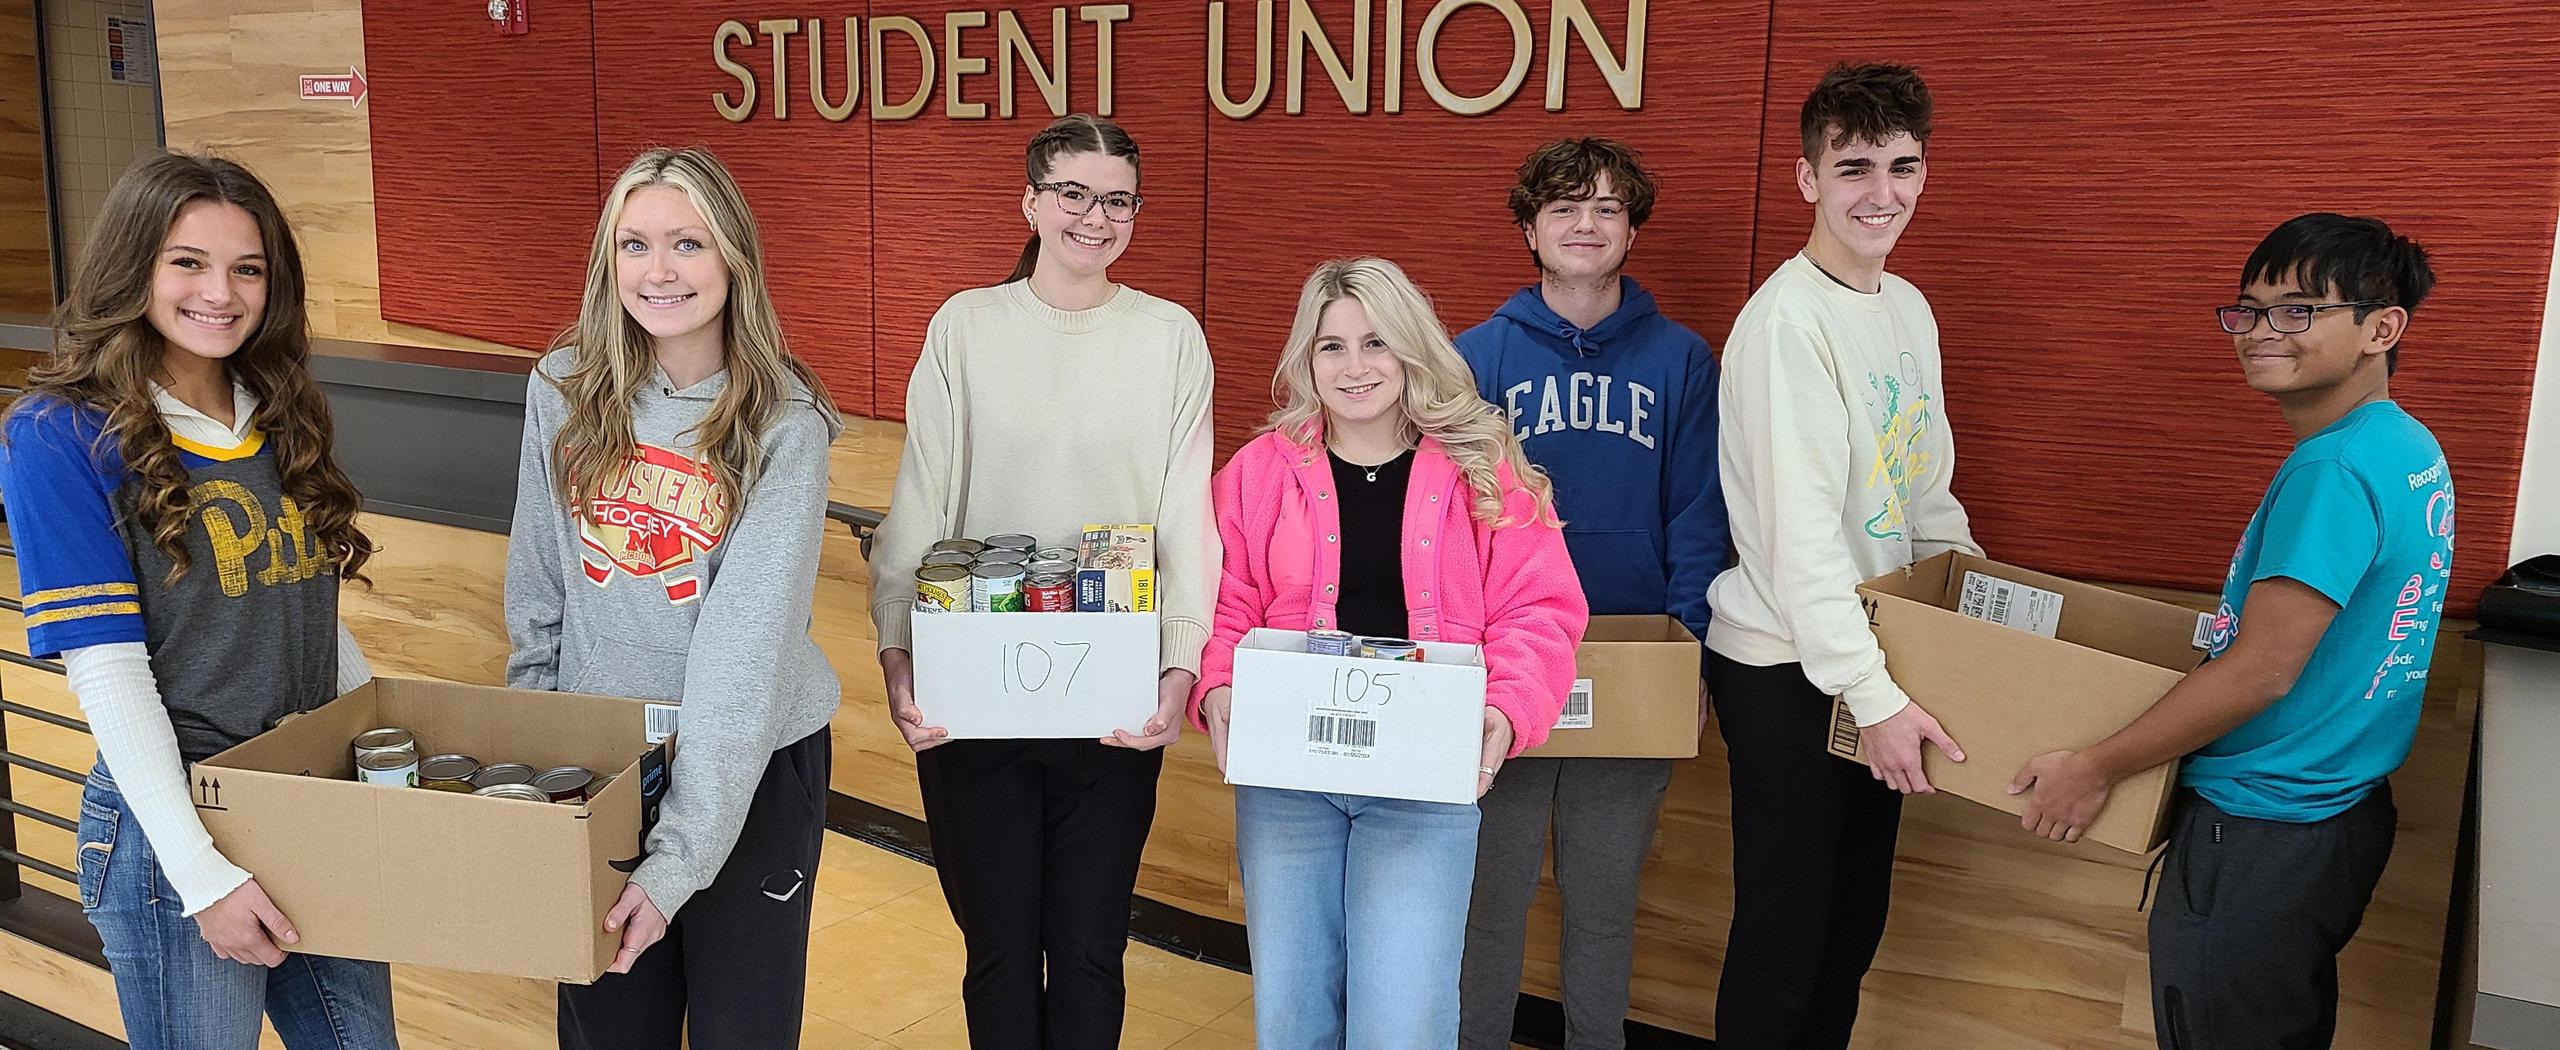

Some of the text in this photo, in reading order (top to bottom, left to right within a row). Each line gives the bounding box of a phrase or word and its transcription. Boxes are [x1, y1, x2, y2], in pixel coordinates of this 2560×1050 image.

[712, 0, 1647, 122] STUDENT UNION
[313, 80, 351, 93] ONE WAY
[1505, 371, 1655, 450] EAGLE
[1002, 640, 1091, 696] 107
[1333, 667, 1401, 706] 105
[642, 763, 663, 791] prime
